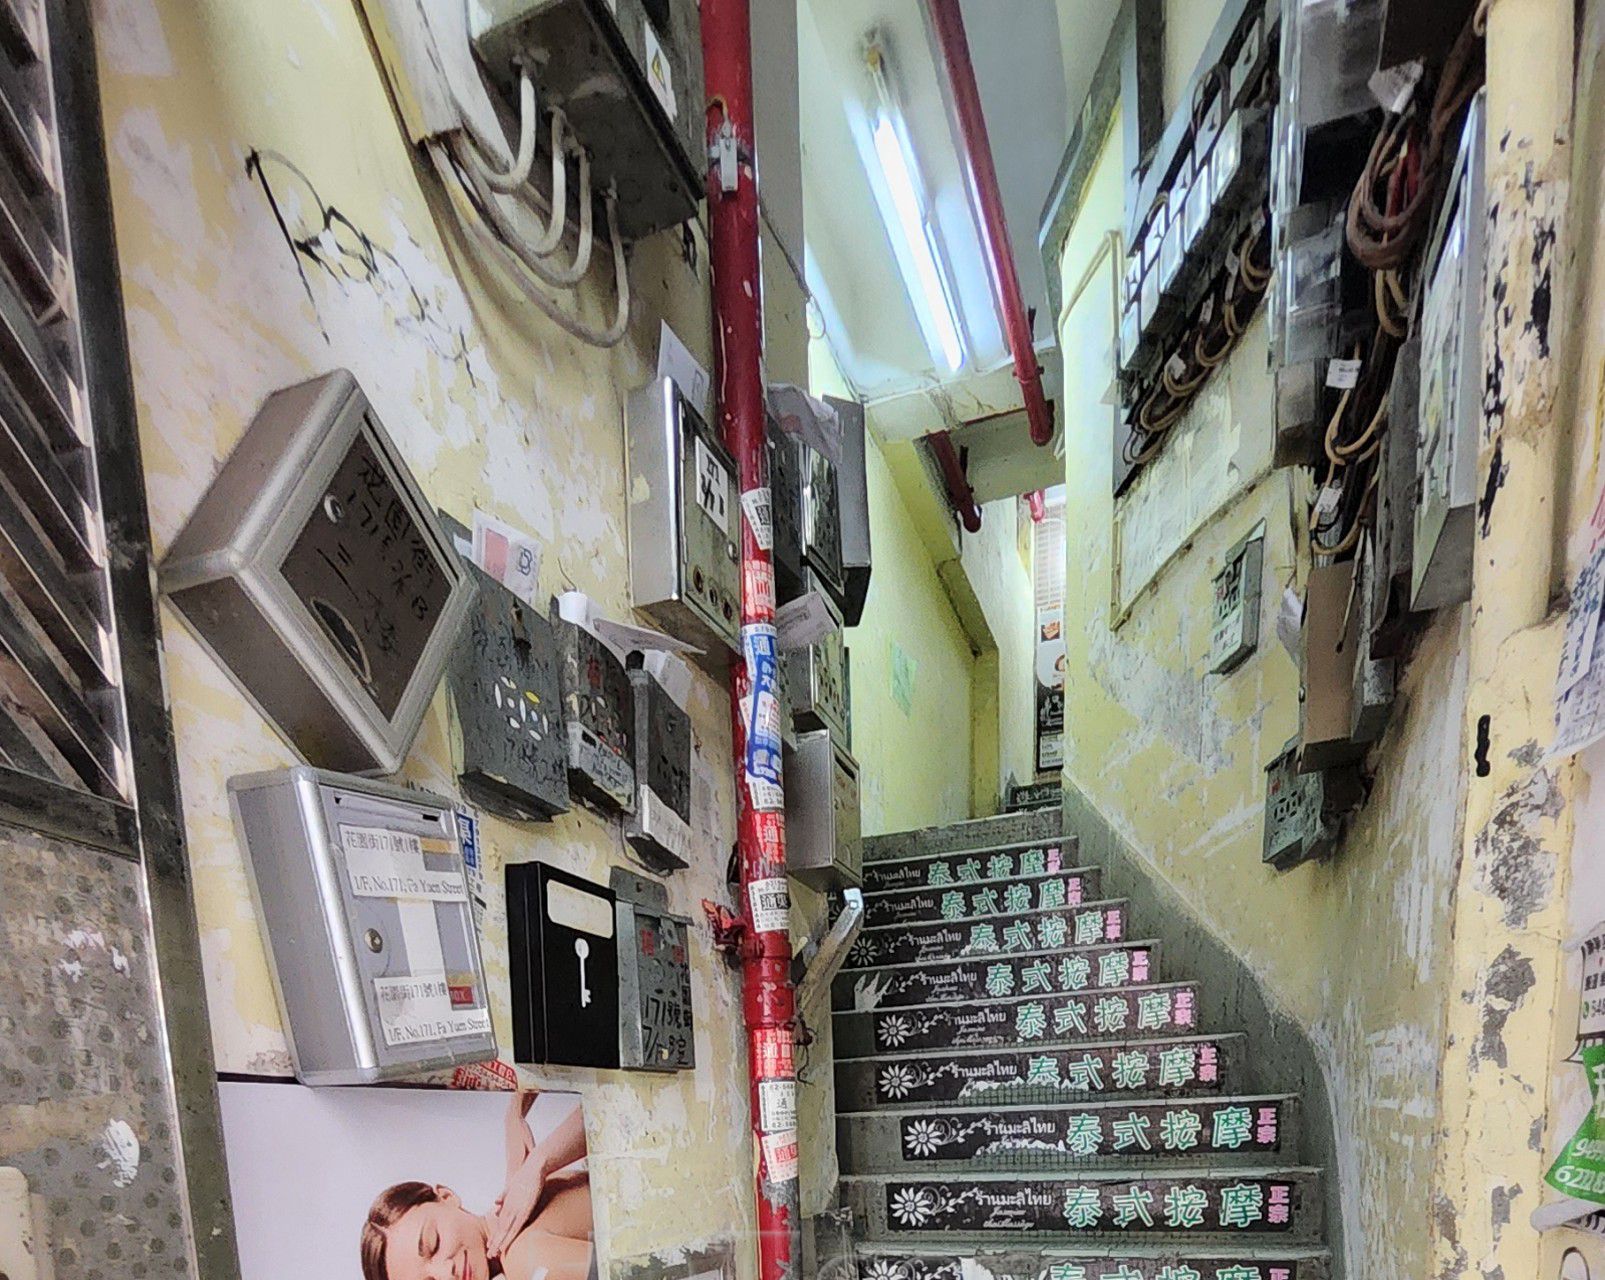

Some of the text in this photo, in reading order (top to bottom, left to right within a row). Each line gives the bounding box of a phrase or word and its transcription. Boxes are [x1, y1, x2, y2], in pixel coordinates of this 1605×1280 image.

[940, 877, 1065, 920] 泰式按摩
[969, 910, 1103, 951] 泰式按摩
[985, 951, 1130, 997] 泰式按摩
[1015, 993, 1171, 1039] 泰式按摩
[1173, 992, 1194, 1026] 正宗
[1026, 1048, 1195, 1091] 泰式按摩
[1198, 1047, 1218, 1082] 正宗
[1066, 1106, 1253, 1155] 泰式按摩
[1256, 1106, 1278, 1144] 正宗
[1063, 1183, 1264, 1228] 泰式按摩
[1268, 1185, 1290, 1223] 正宗
